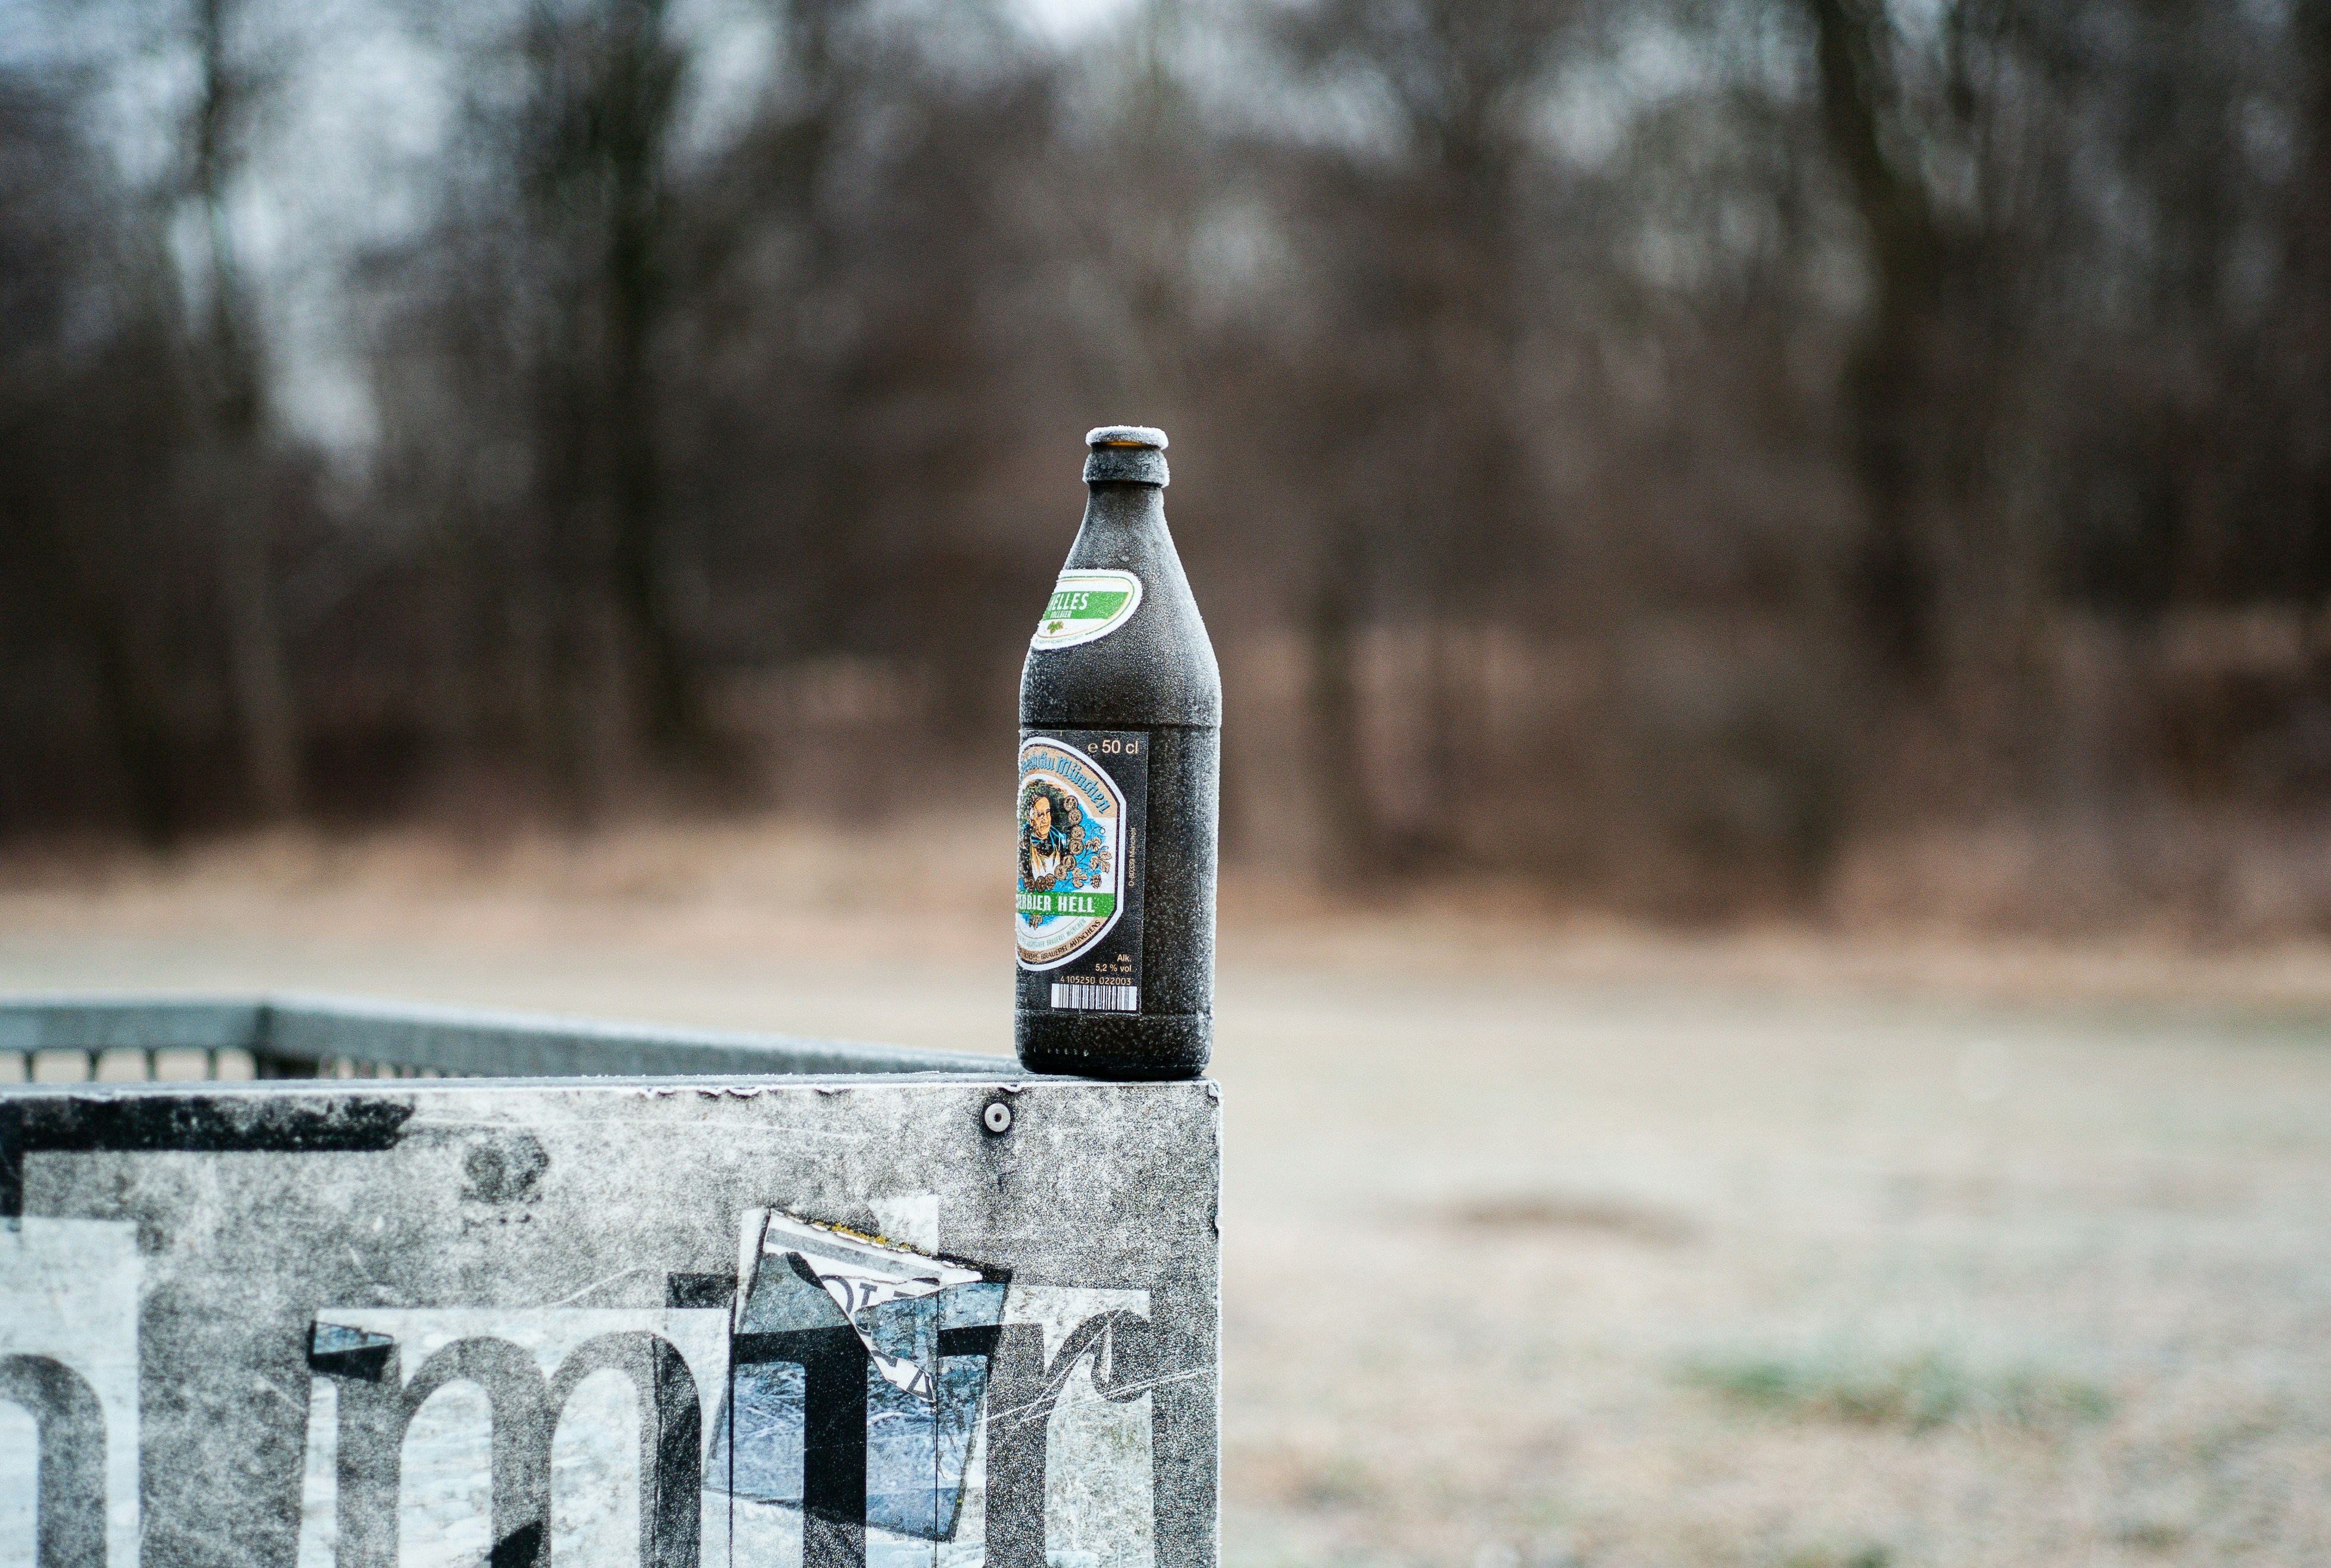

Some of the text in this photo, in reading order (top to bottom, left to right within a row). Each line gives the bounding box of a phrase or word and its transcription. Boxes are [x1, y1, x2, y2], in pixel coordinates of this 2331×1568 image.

[1102, 741, 1121, 754] 50
[1126, 741, 1138, 754] cl
[1055, 756, 1111, 814] München
[1058, 896, 1095, 913] HELL
[1040, 945, 1068, 960] BRAUEREI
[1070, 920, 1101, 948] MÜNCHENS
[1046, 934, 1065, 945] BRAUEREI
[1066, 918, 1086, 936] MÜNCHEN
[1095, 963, 1107, 972] 5,2
[1110, 964, 1117, 972] %
[1099, 977, 1131, 985] 022003
